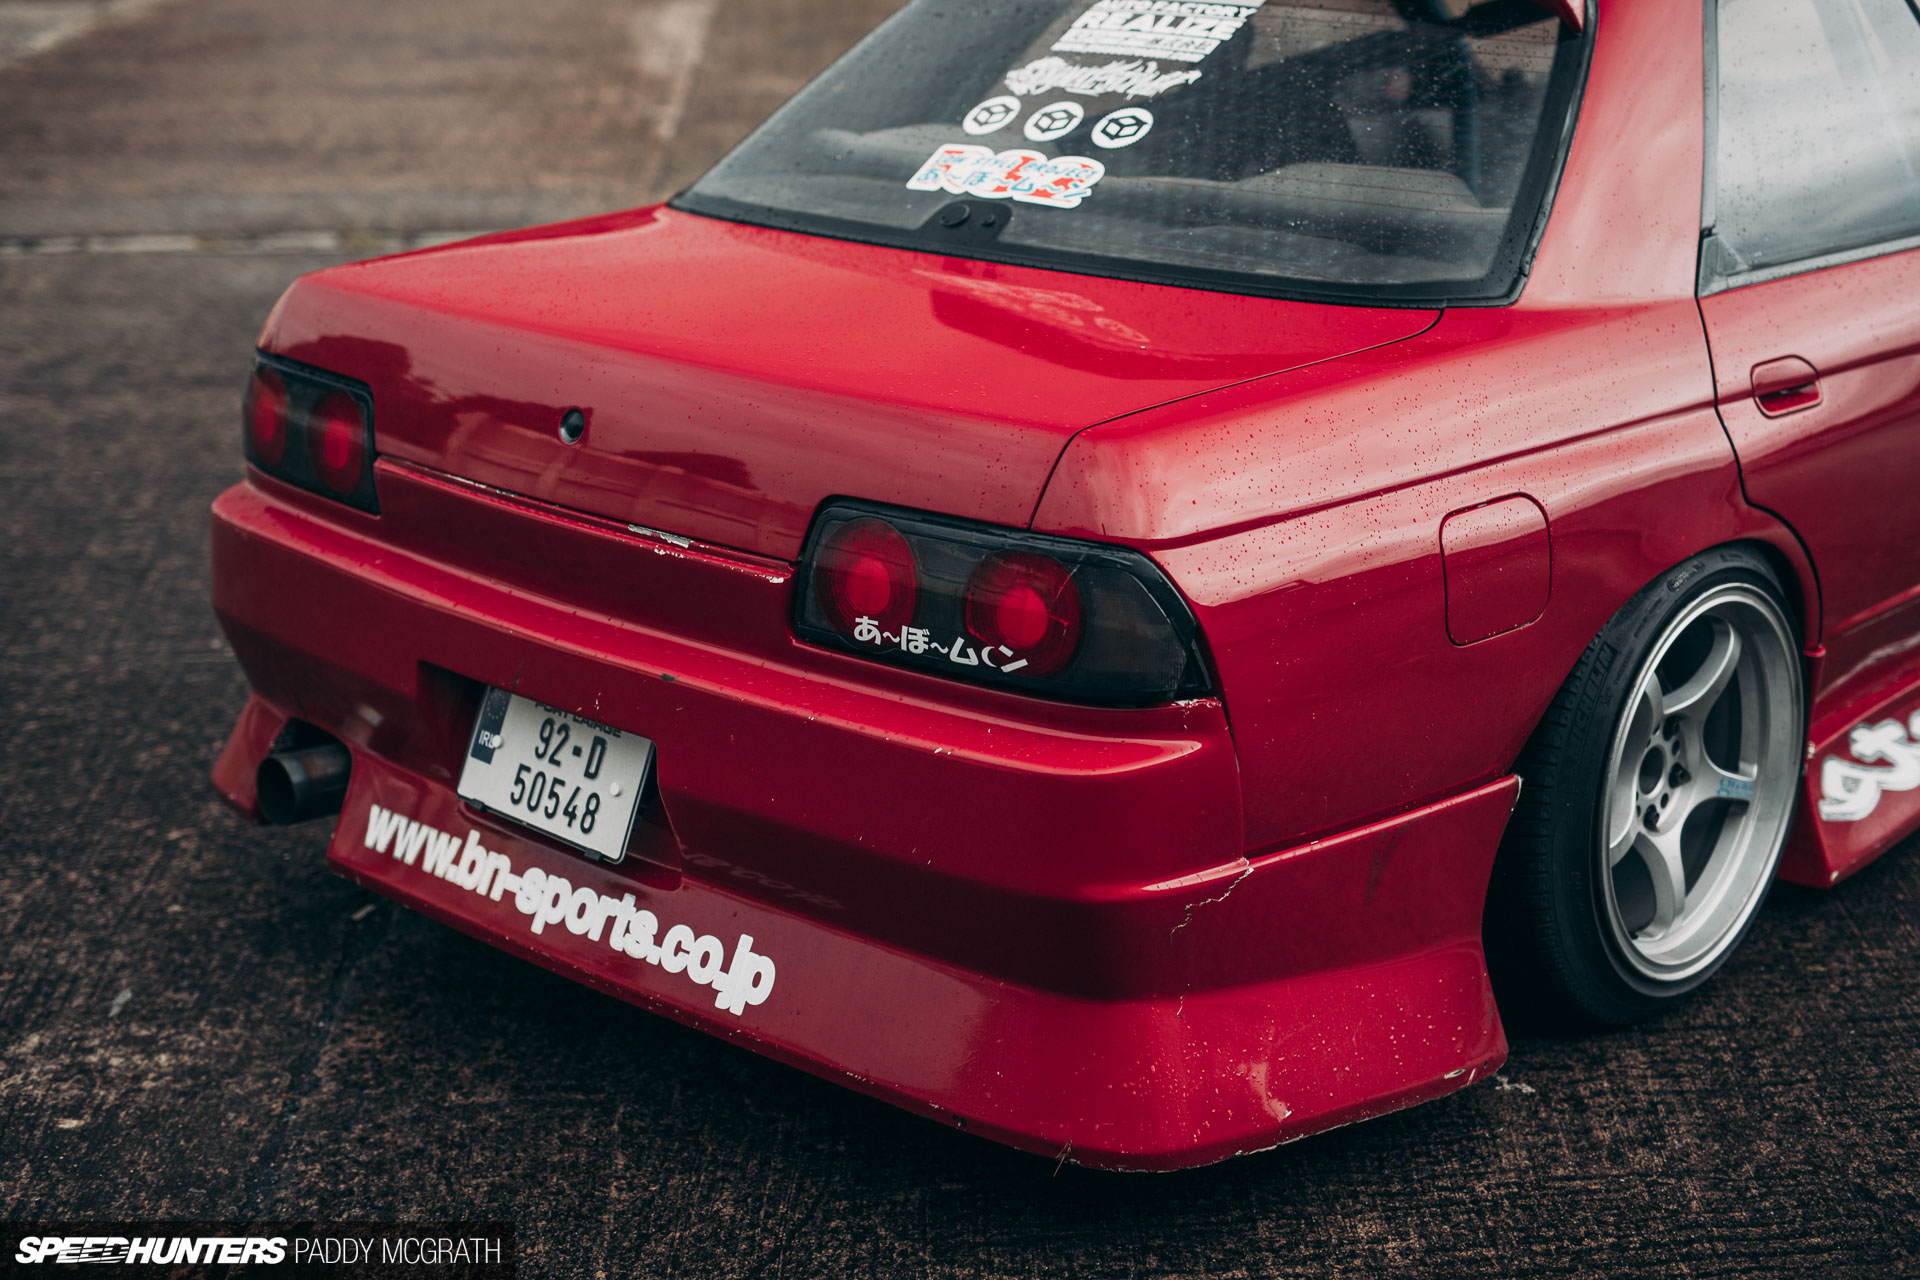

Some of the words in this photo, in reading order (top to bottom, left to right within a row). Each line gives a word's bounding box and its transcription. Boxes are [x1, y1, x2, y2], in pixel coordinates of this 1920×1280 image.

[1071, 9, 1245, 41] REALIZE
[1021, 160, 1097, 180] PROJECT
[478, 729, 496, 749] IRL
[534, 717, 608, 780] 92-D
[510, 763, 601, 834] 50548
[363, 804, 777, 1016] www.bn-sports.co.jp
